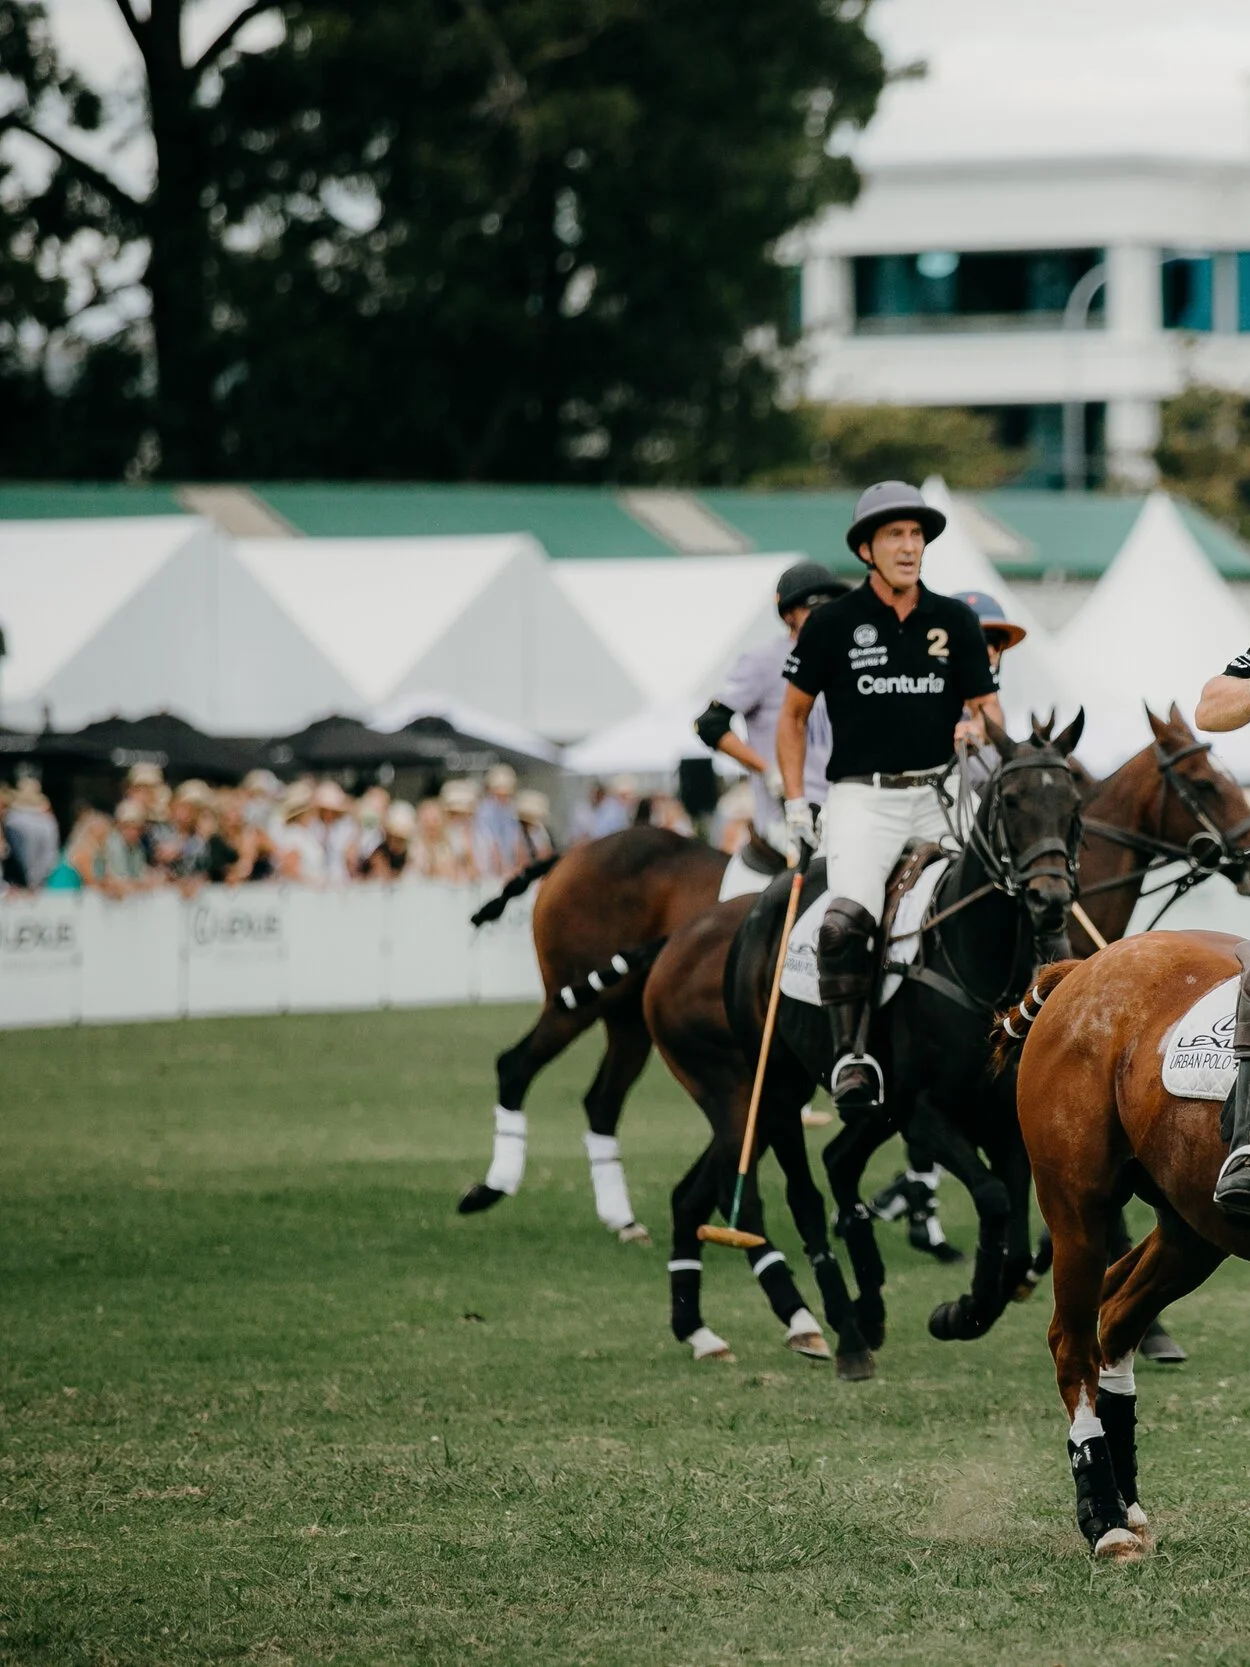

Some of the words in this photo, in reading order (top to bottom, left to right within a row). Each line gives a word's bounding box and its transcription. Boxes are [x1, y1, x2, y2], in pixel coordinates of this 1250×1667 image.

[927, 628, 950, 657] 2
[857, 672, 945, 695] Centuria
[1169, 1052, 1203, 1070] URBAN
[1202, 1053, 1232, 1070] POLO
